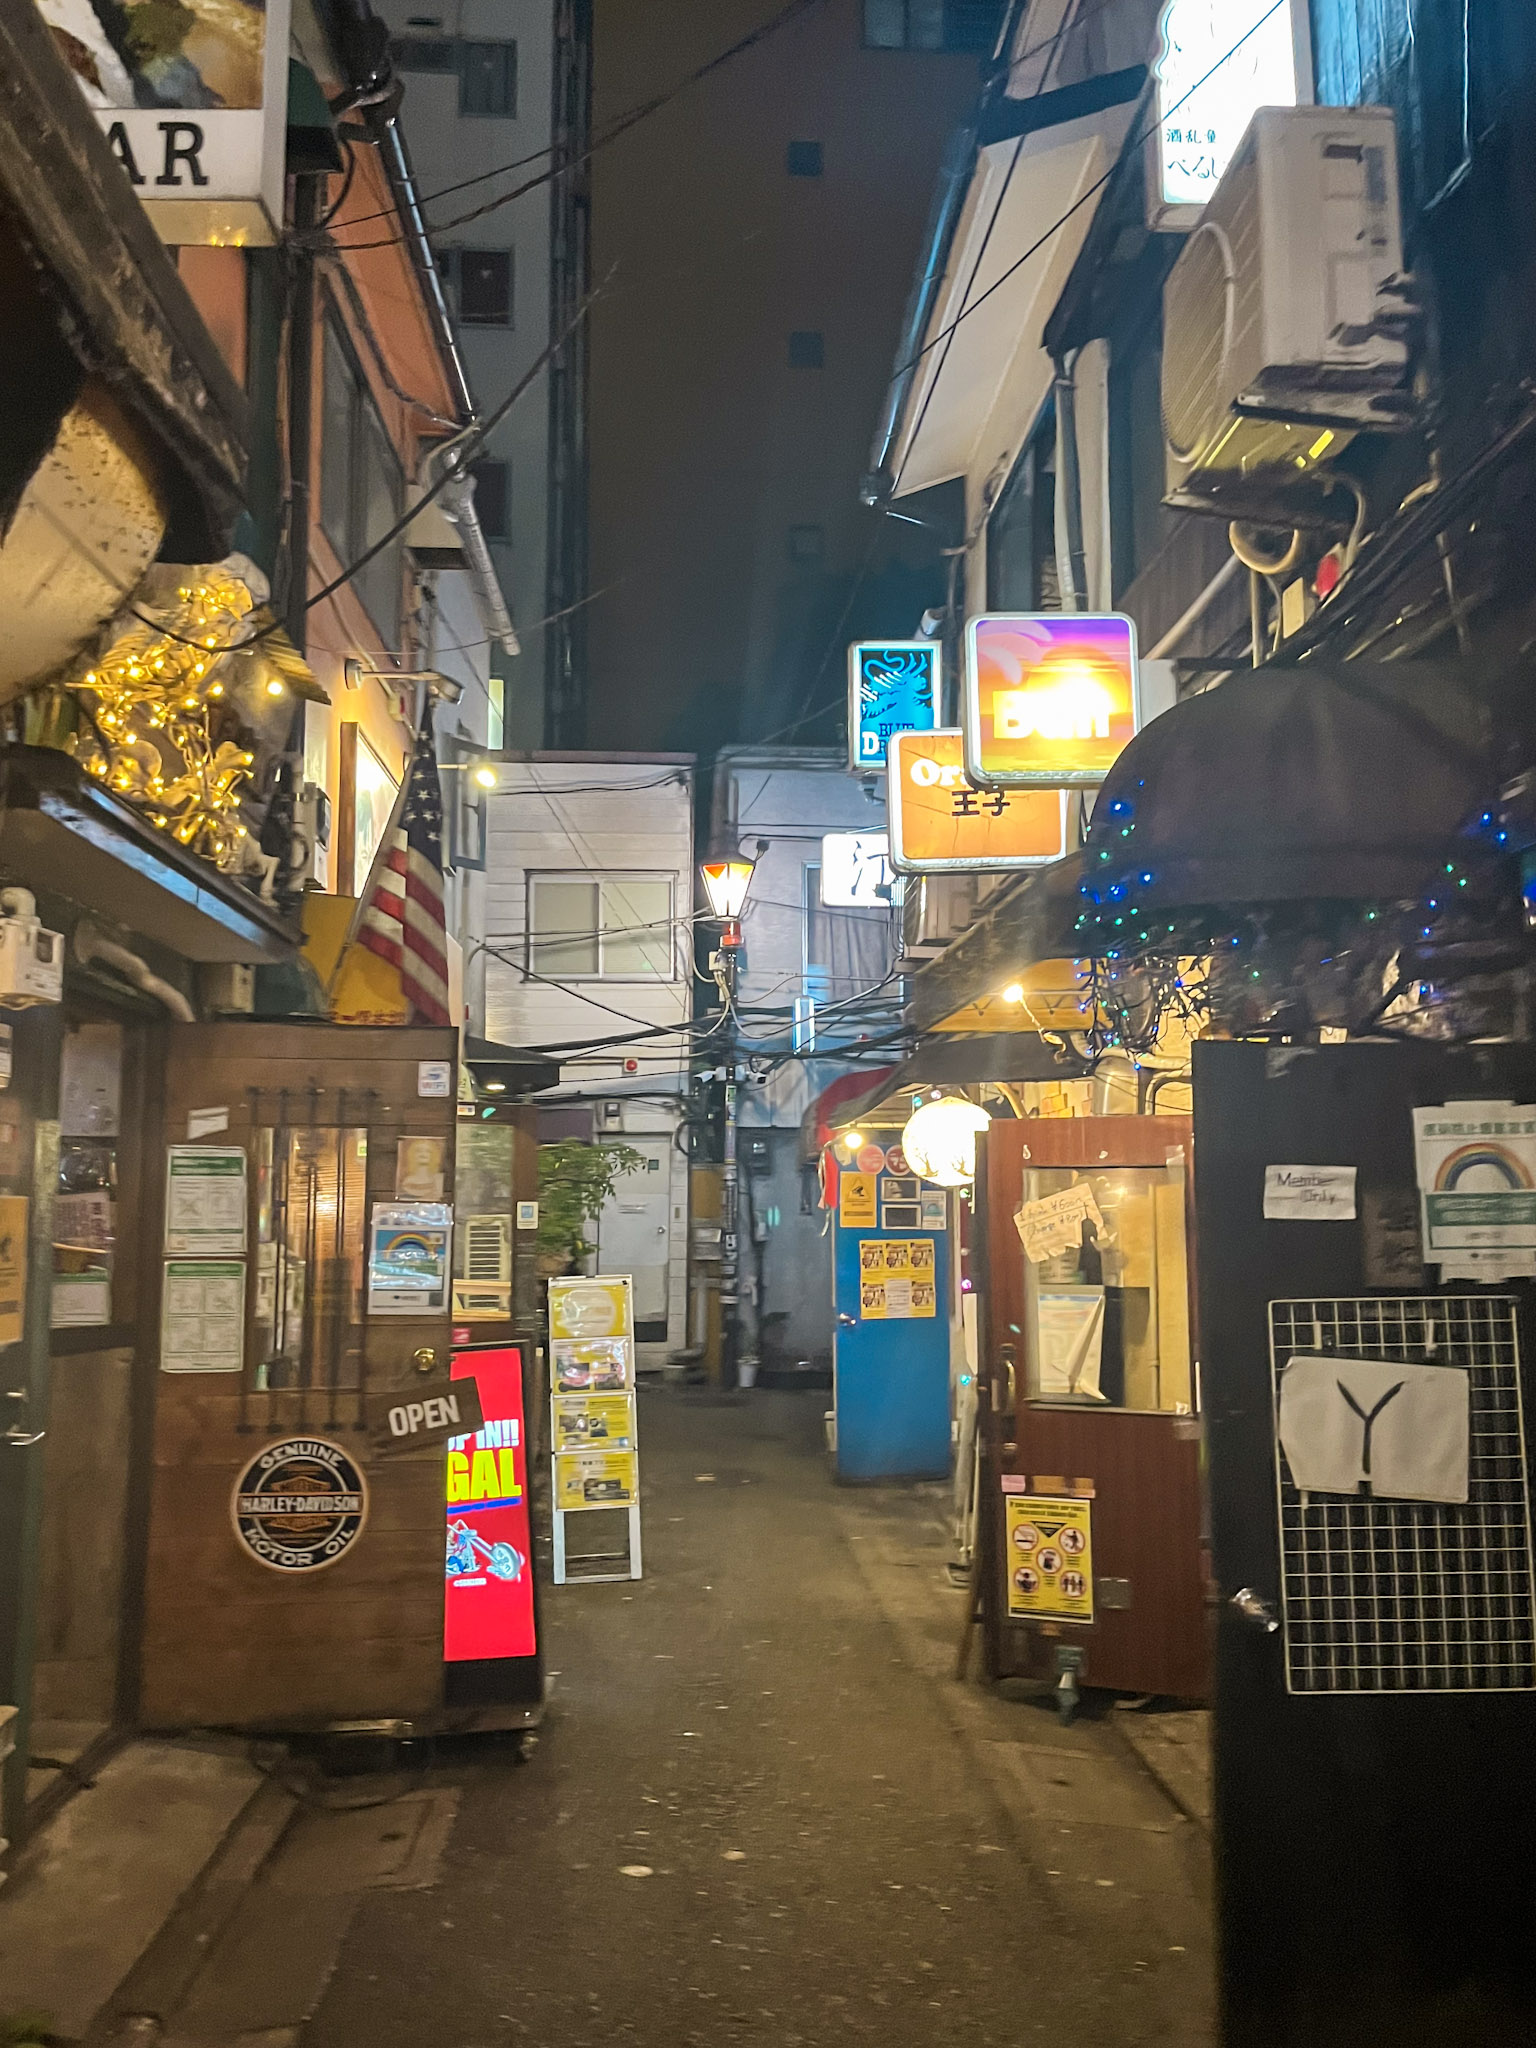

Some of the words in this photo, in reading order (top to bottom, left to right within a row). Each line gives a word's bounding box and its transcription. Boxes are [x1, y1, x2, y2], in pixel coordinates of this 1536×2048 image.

[951, 790, 1011, 817] 王子
[388, 1394, 460, 1436] OPEN
[260, 1443, 344, 1469] GENUINE
[447, 1448, 522, 1501] GAL
[241, 1496, 359, 1513] HARLEY-DAVIDSON
[244, 1528, 314, 1566] MOTOR
[325, 1529, 355, 1555] OIL
